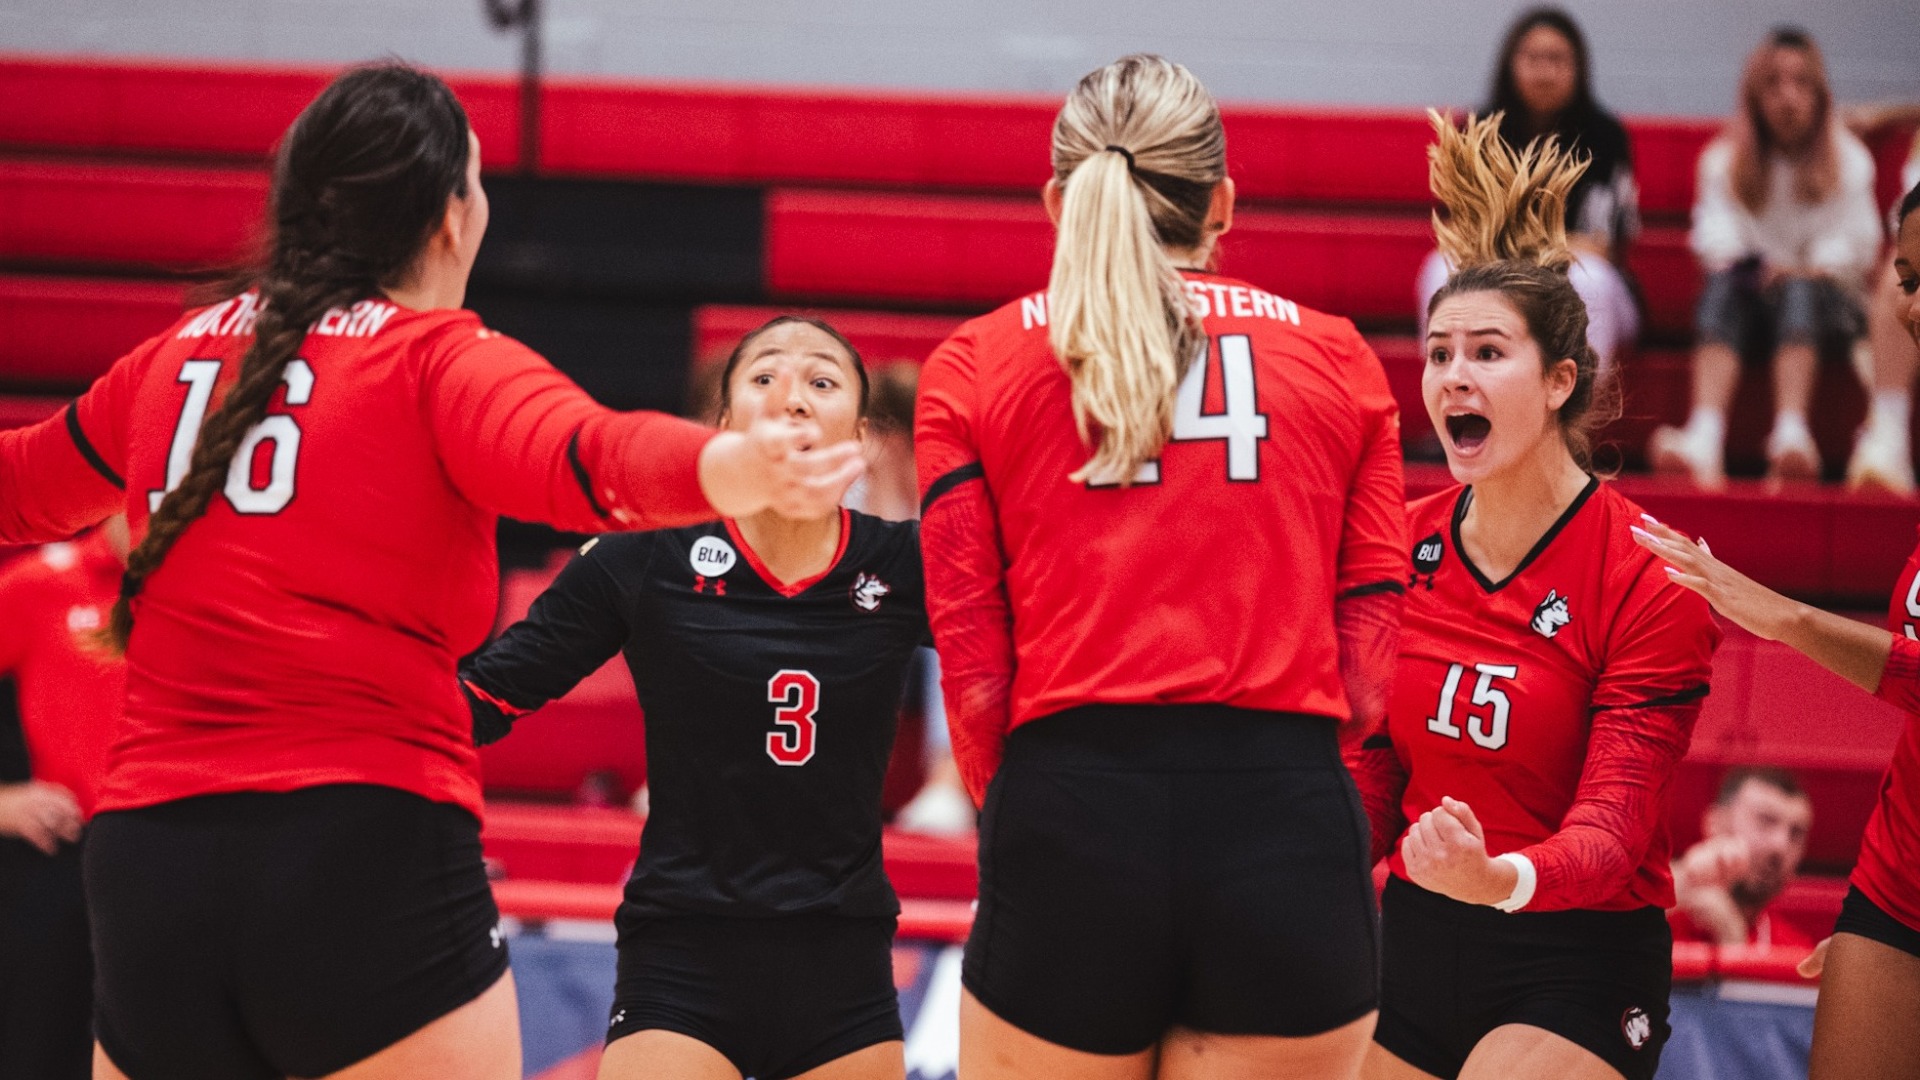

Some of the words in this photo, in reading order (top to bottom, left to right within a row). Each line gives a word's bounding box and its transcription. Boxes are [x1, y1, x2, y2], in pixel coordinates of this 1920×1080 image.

[1020, 280, 1301, 330] NSTERN
[147, 358, 316, 516] 16
[1085, 333, 1269, 489] 4
[697, 546, 728, 565] BLM
[766, 669, 821, 767] 3
[1426, 662, 1519, 751] 15
